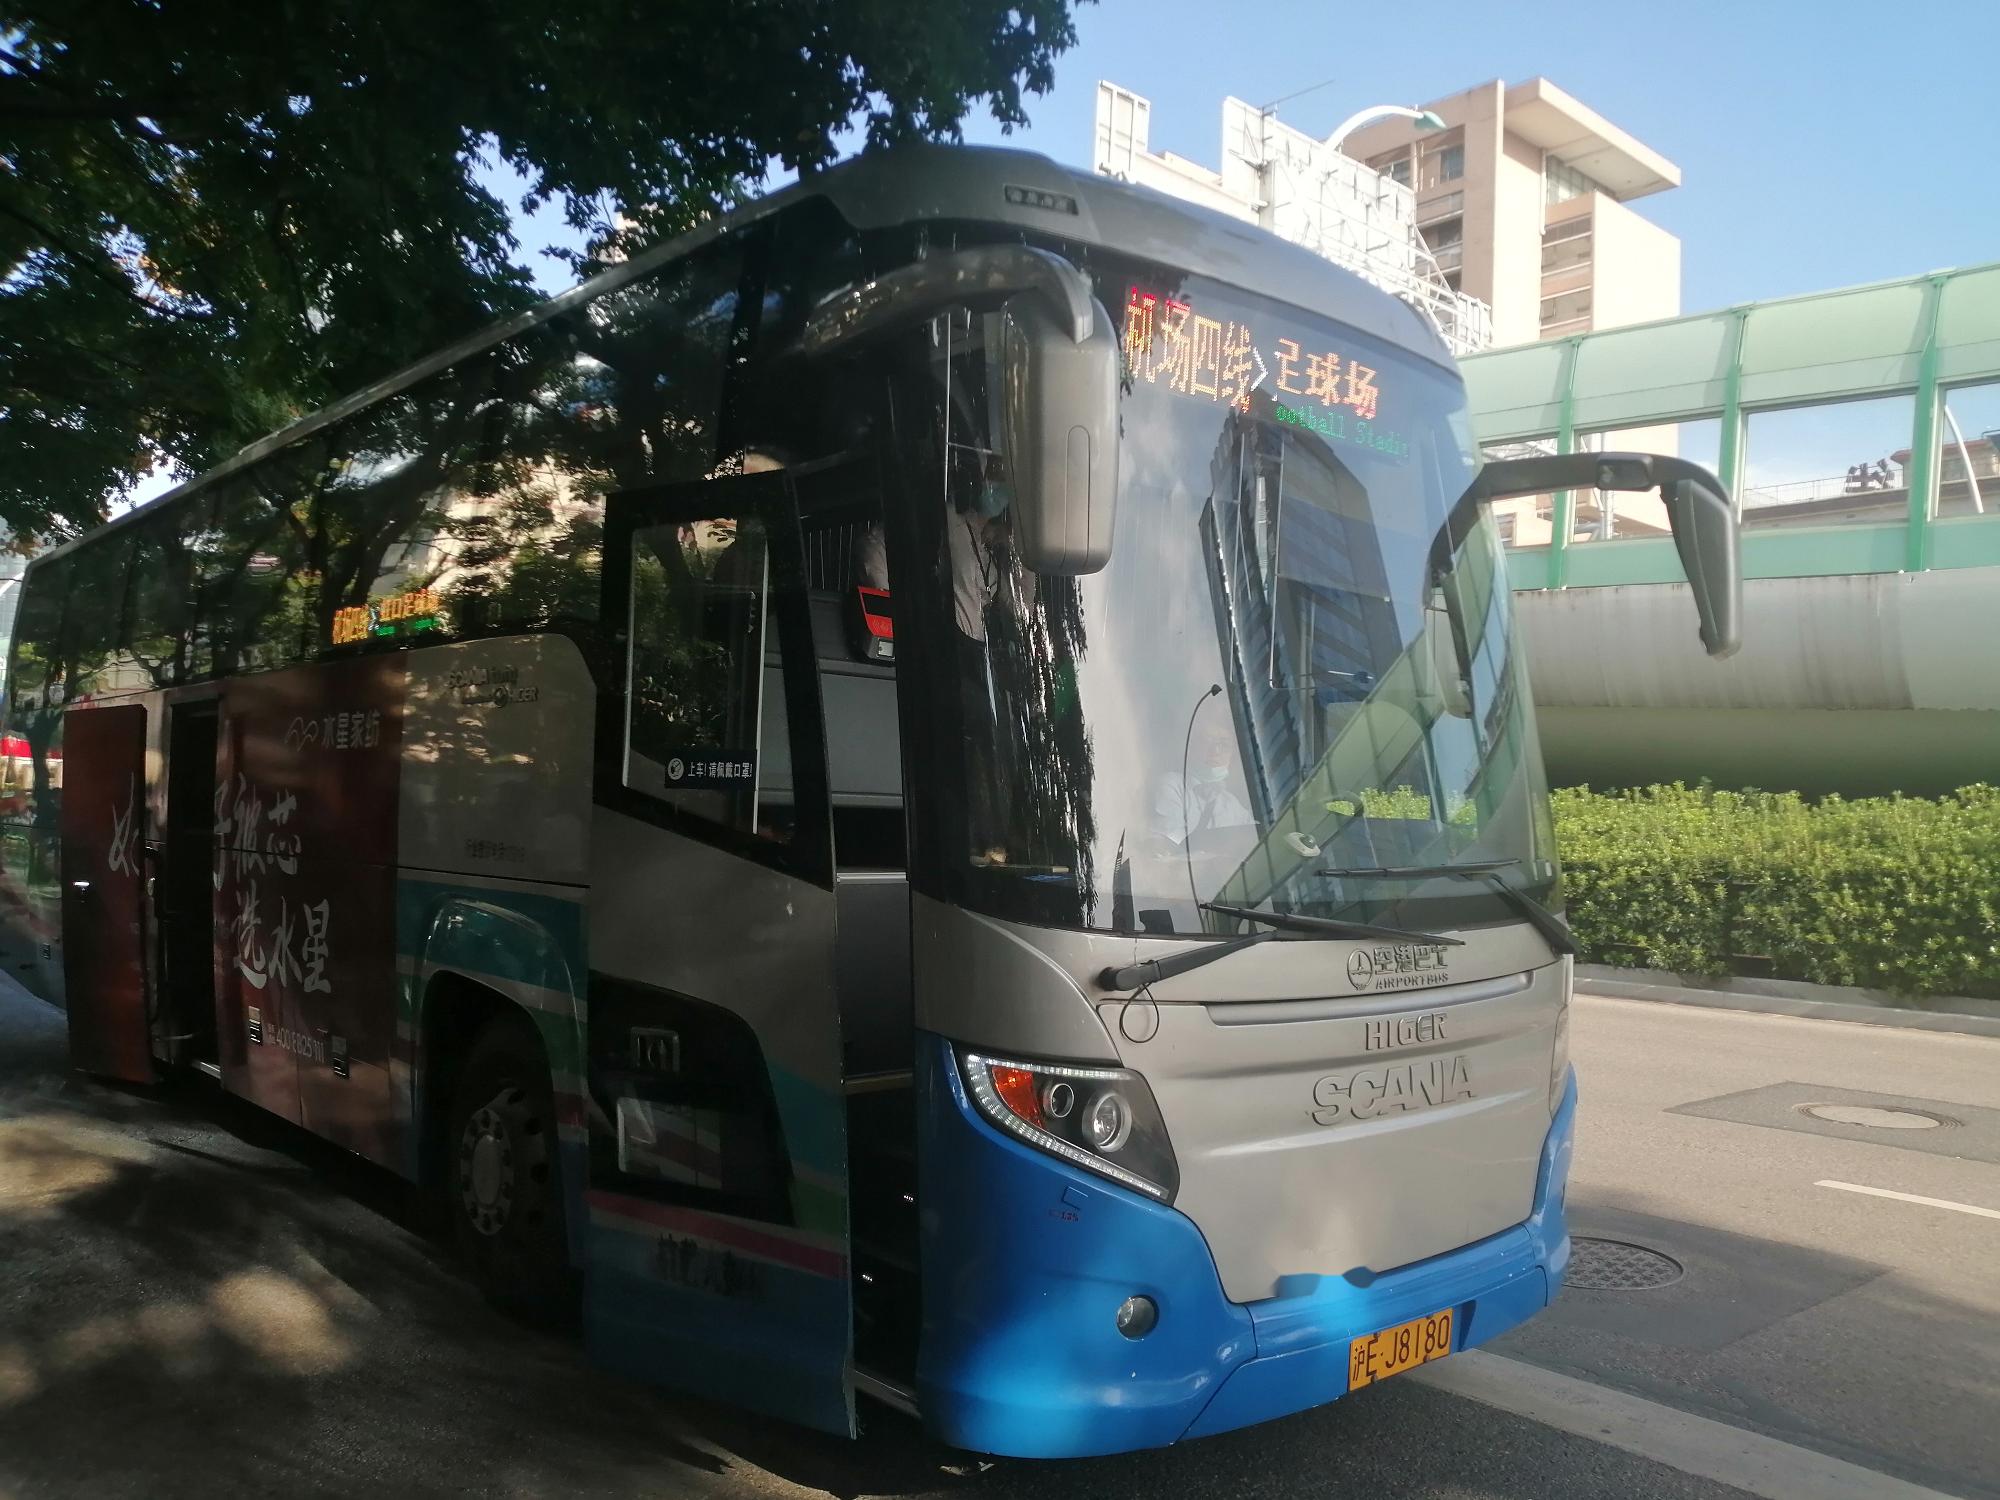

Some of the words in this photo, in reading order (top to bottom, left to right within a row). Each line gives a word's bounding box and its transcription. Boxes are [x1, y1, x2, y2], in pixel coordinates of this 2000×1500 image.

[1125, 286, 1252, 413] 机场四线
[321, 708, 382, 750] 水星家纺
[232, 881, 332, 994] 选水星
[1364, 1012, 1448, 1051] HIGER
[1311, 1055, 1477, 1127] SCANIA
